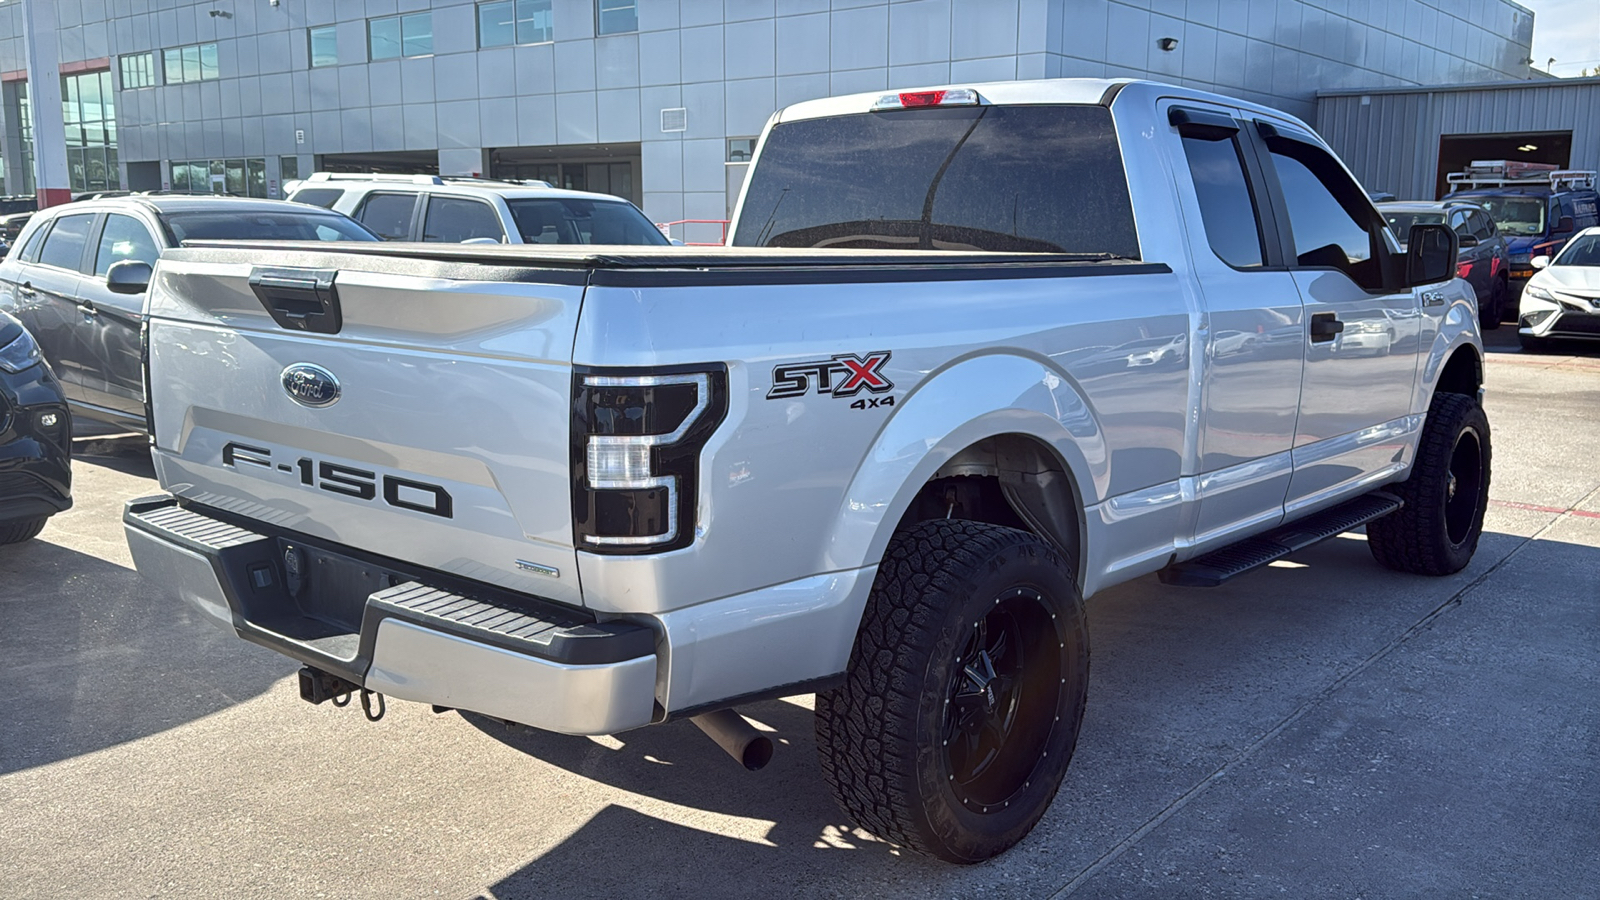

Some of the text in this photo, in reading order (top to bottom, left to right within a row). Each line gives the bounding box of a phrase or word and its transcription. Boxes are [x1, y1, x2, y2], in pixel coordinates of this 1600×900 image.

[288, 370, 324, 398] Ford
[766, 350, 895, 400] STX
[222, 440, 453, 519] F-150
